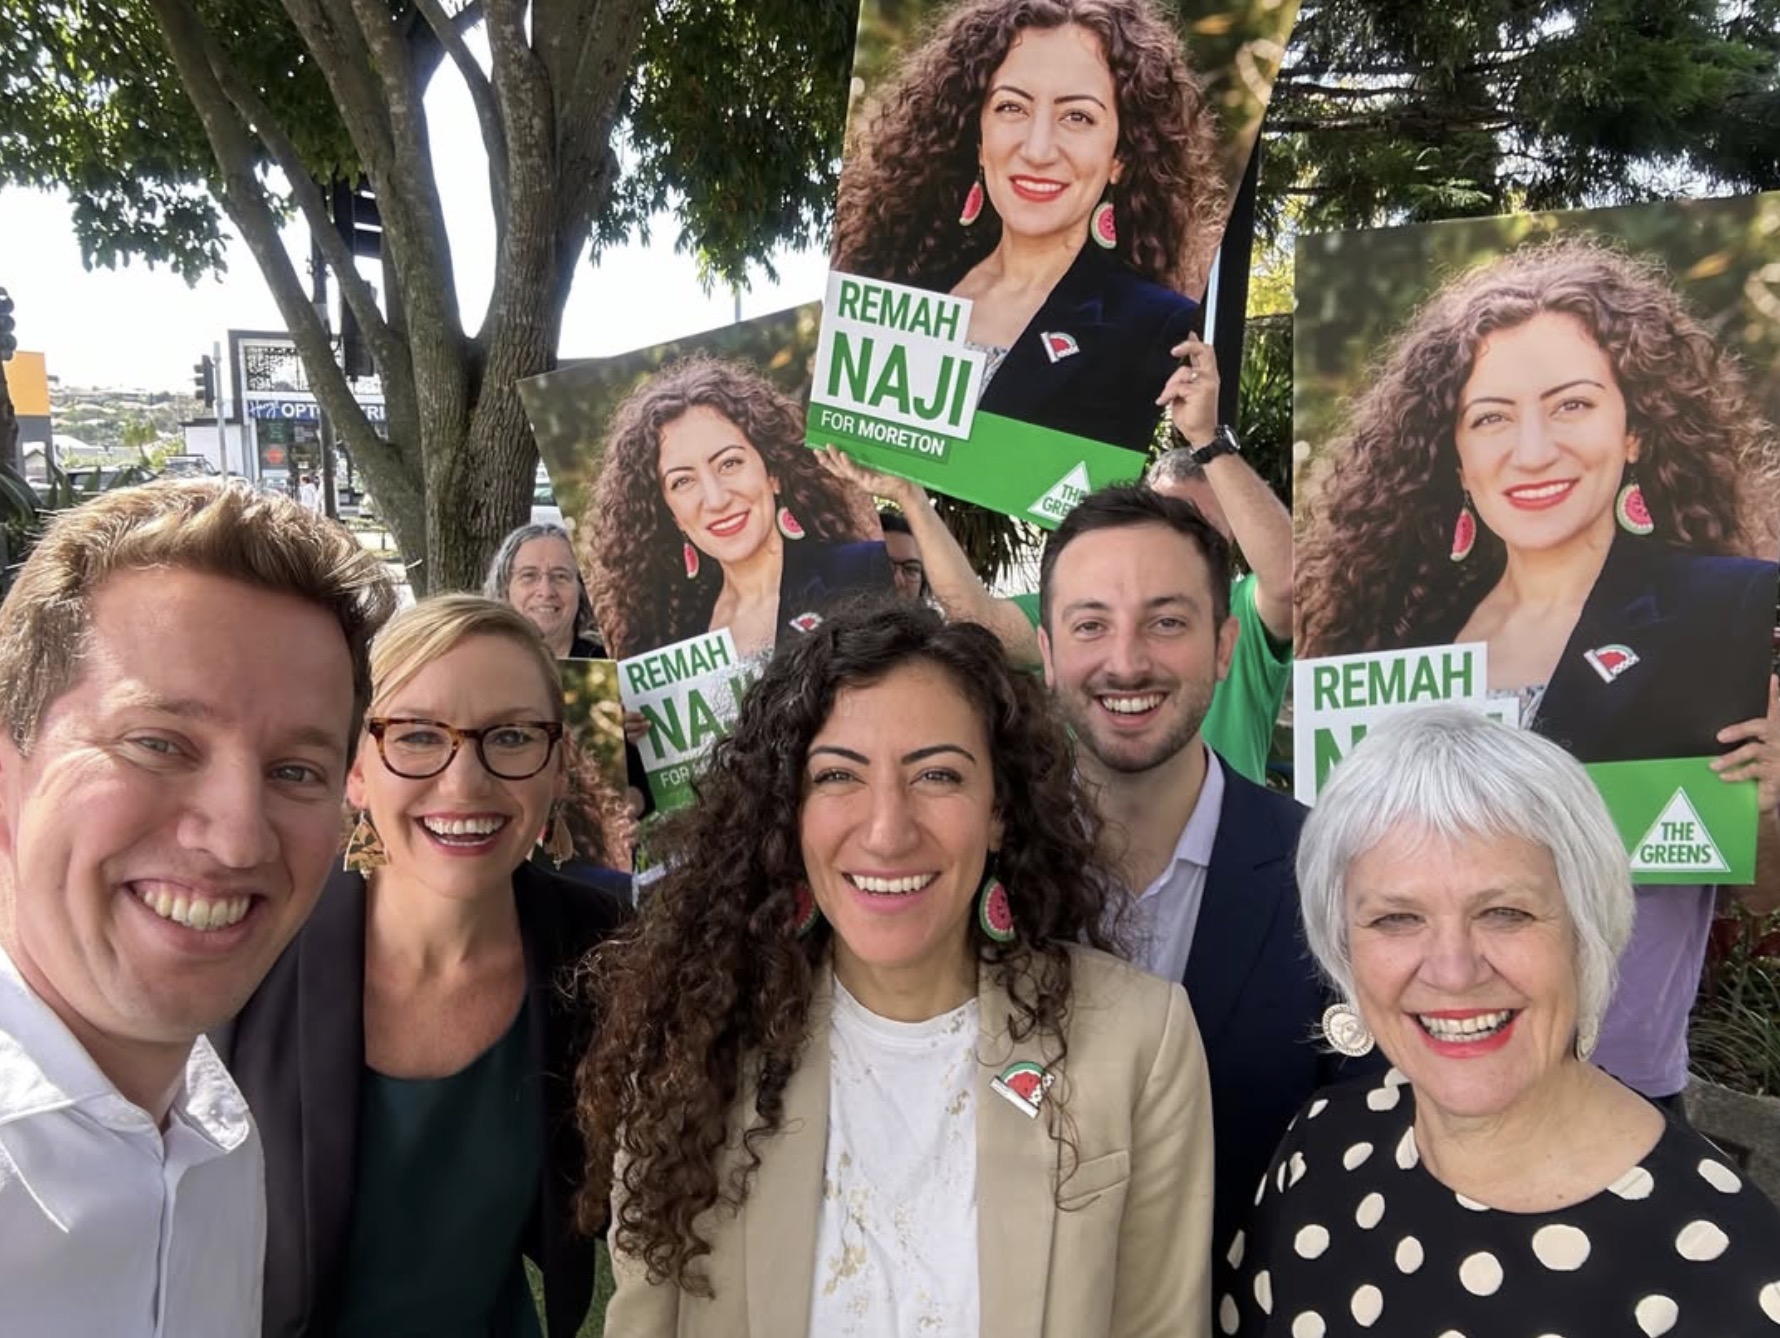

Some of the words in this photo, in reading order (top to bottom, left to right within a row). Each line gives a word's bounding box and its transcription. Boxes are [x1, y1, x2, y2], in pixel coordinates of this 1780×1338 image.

[838, 280, 961, 341] REMAH
[827, 331, 973, 427] NAJI
[821, 410, 855, 434] FOR
[857, 420, 945, 457] MORETON
[1042, 496, 1074, 517] GRE
[626, 636, 730, 694] REMAH
[1313, 652, 1473, 710] REMAH
[660, 766, 689, 788] FOR
[1640, 844, 1711, 864] GREENS
[1661, 821, 1694, 840] THE
